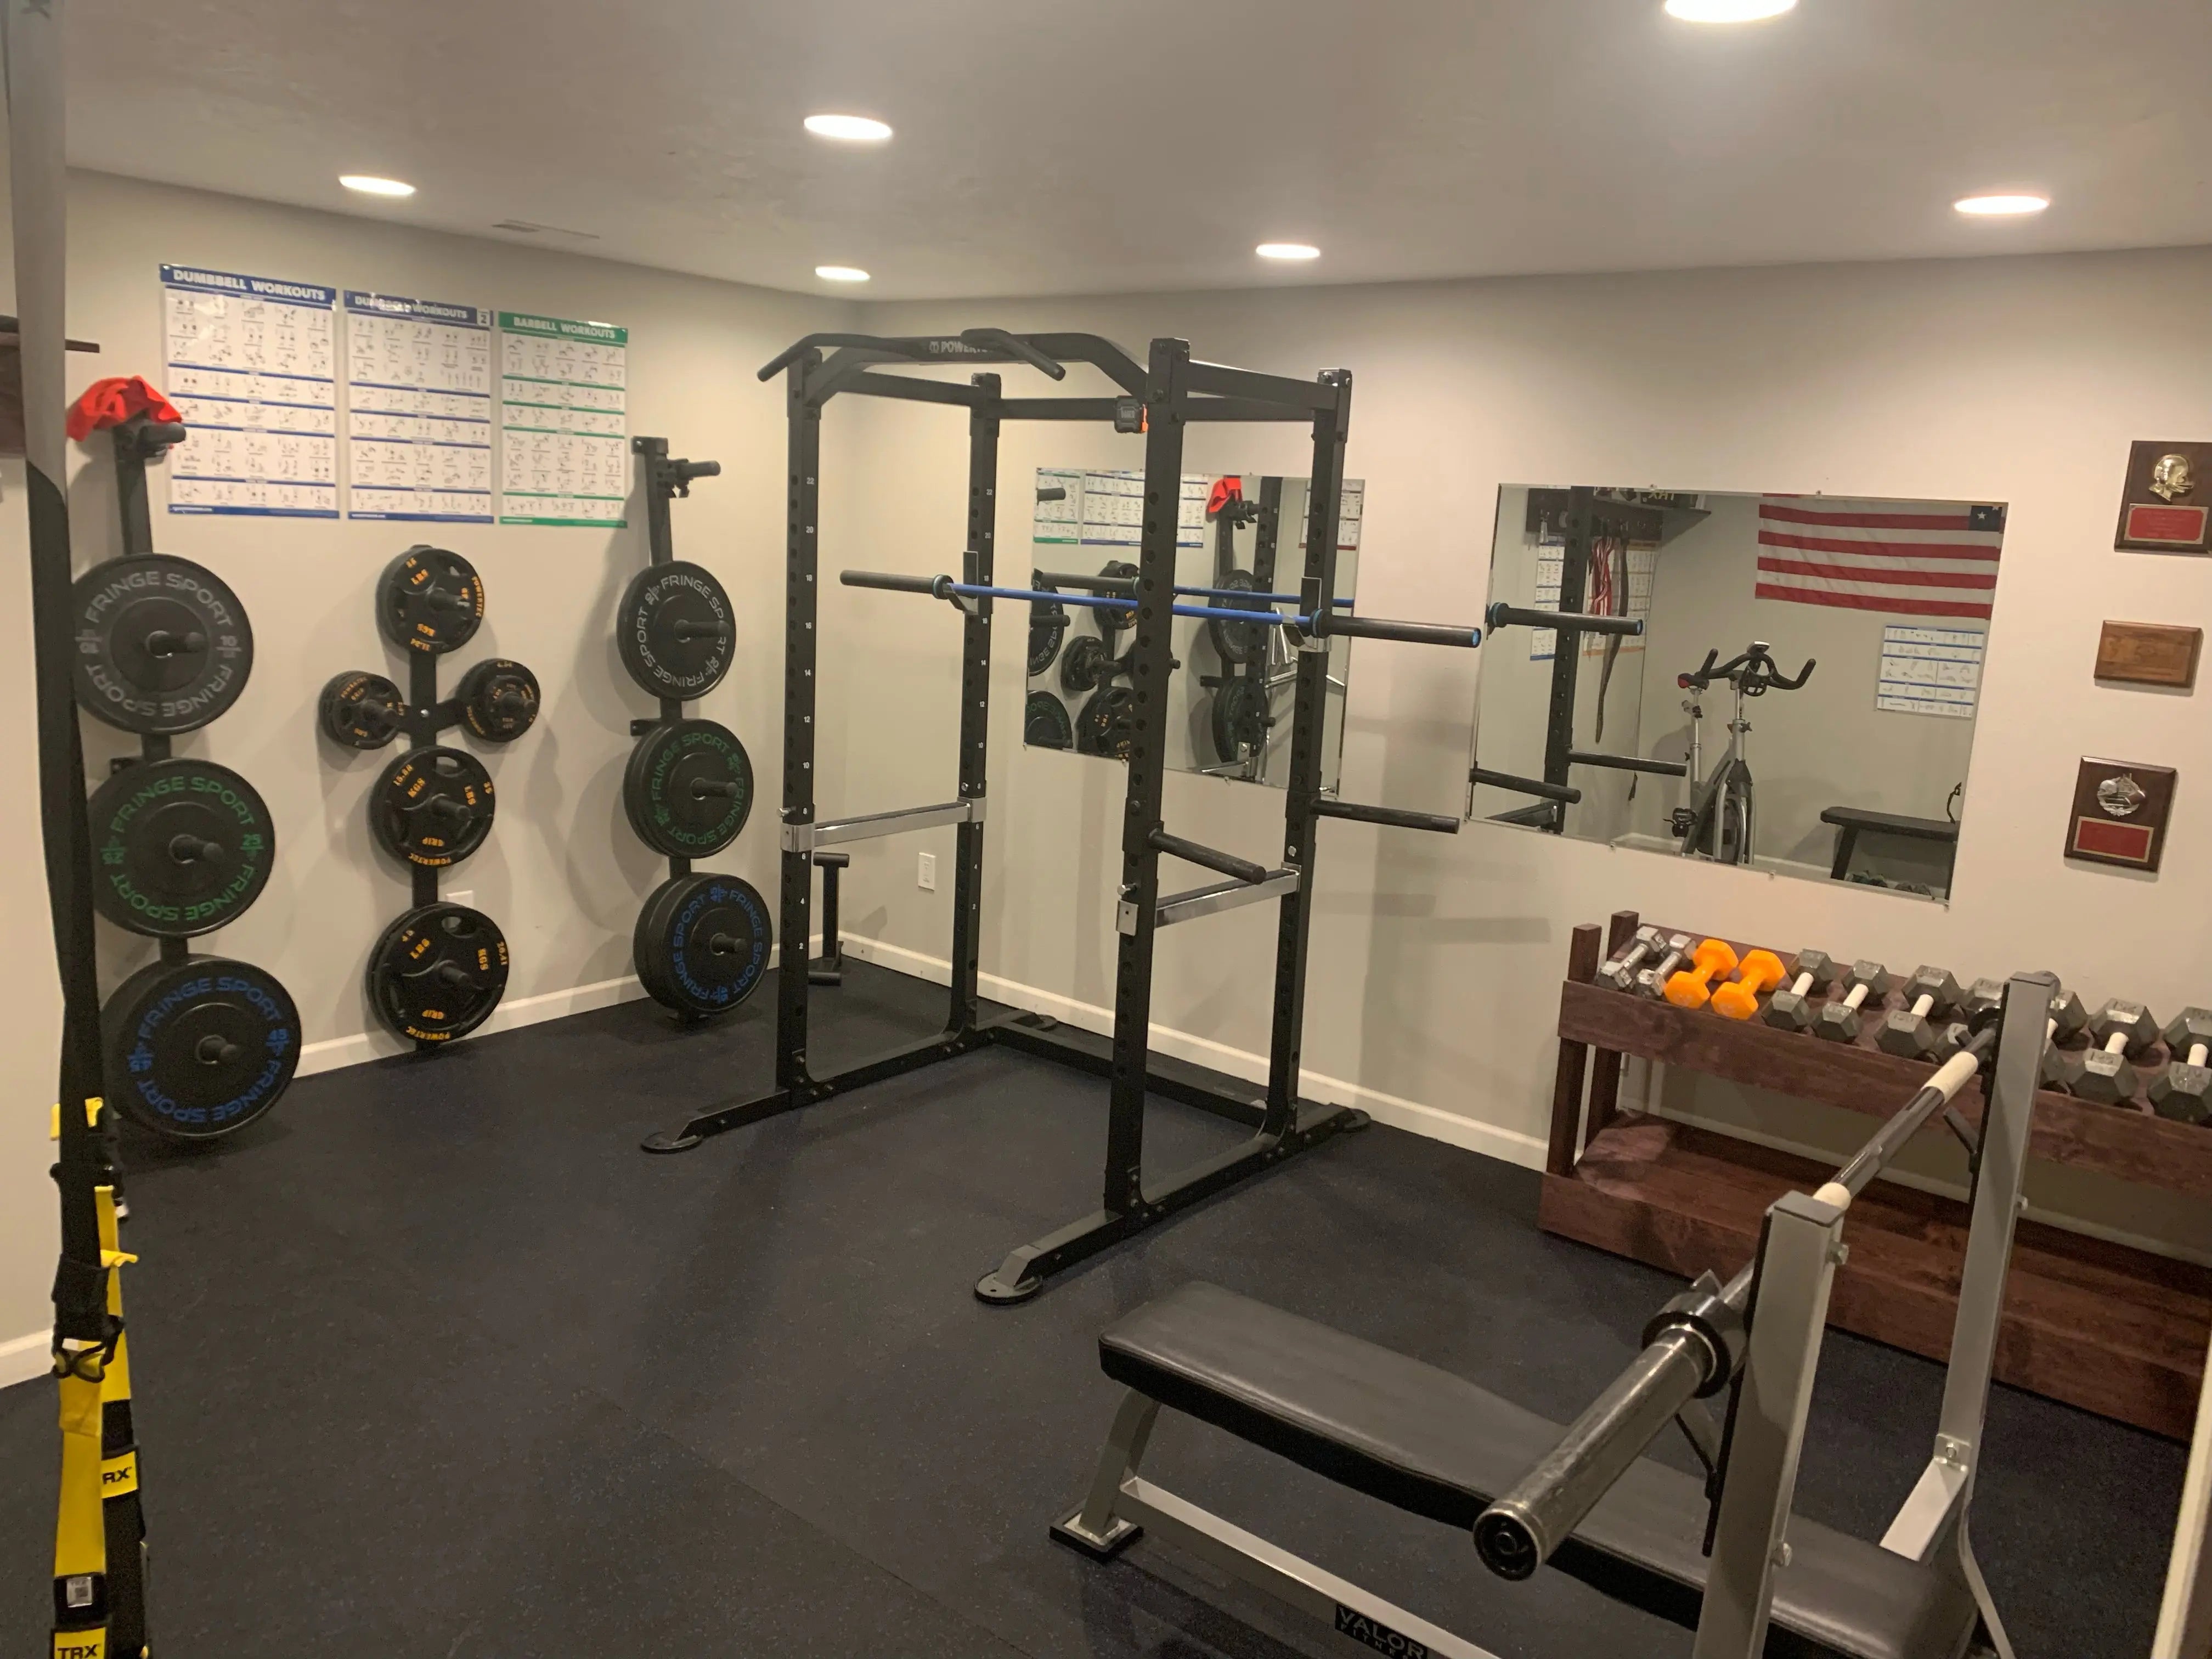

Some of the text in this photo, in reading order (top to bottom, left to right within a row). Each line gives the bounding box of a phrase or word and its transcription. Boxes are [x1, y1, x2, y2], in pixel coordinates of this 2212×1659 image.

[173, 269, 326, 301] DUMBBELL WORKOUTS
[480, 314, 487, 324] 2
[513, 317, 616, 340] BARBELL WORKOUTS
[941, 341, 991, 353] POWER
[85, 571, 233, 627] FRINGE SPORT
[471, 575, 485, 618] POWERTEC
[660, 575, 727, 654] FRINGE SPRT
[636, 606, 705, 687] FRINGE SPORT
[85, 664, 233, 717] FRINGE SPORT
[651, 733, 730, 802] FRINGE SPORT
[110, 776, 255, 833] FRINGE SPORT
[667, 776, 744, 845] FRINGE SPORT
[408, 852, 452, 866] POWERTEC
[110, 864, 256, 921] FRINGE SPORT
[496, 941, 508, 966] 20.41
[673, 894, 710, 1000] FRINGE SPORT
[729, 889, 763, 994] FRINGE SPORT
[137, 977, 282, 1040] FRINGE SPORT
[405, 1025, 452, 1041] POWERTEC
[137, 1060, 283, 1123] FRINGE SPORT
[102, 1466, 129, 1485] RX
[57, 1644, 98, 1659] TRX
[1339, 1607, 1424, 1659] VALOR
